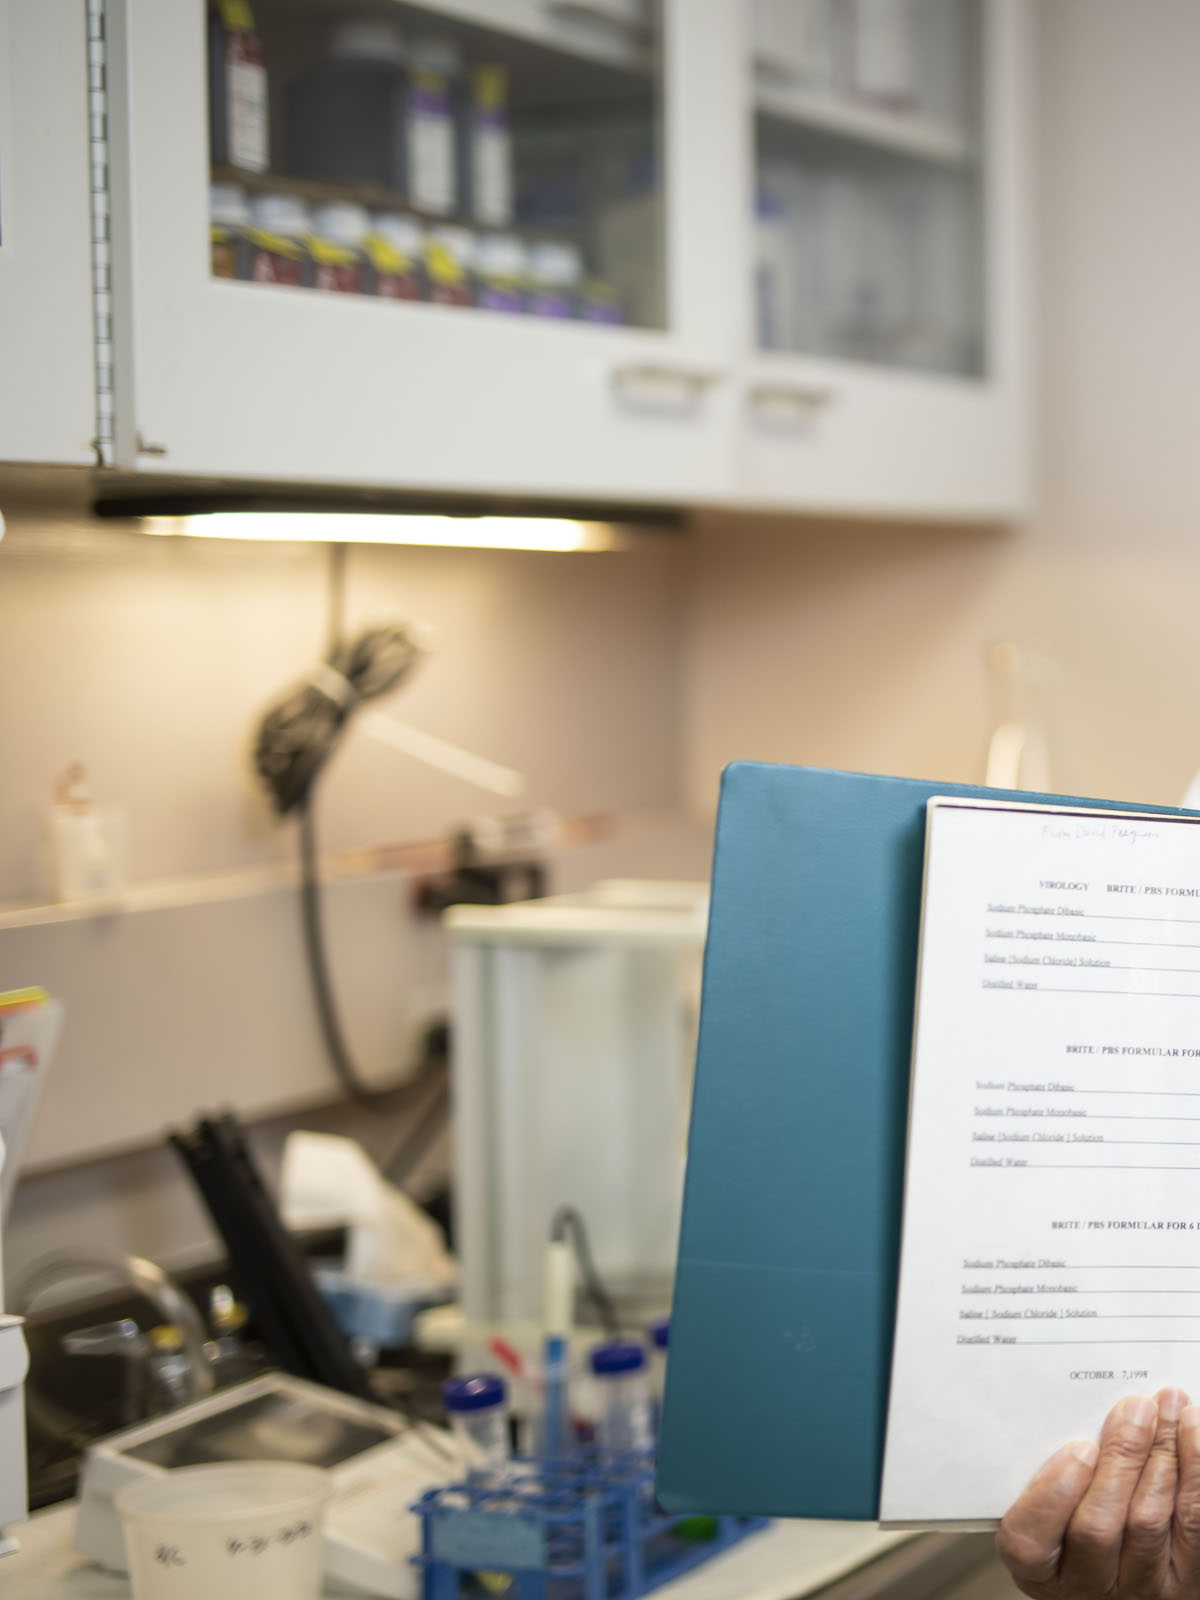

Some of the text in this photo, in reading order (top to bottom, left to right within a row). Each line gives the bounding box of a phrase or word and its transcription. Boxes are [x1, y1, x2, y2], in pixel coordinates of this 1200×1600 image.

[1039, 880, 1089, 894] VIROLOGY
[1106, 884, 1136, 896] BRITE
[1144, 885, 1162, 897] PBS
[1079, 956, 1111, 969] Solution
[1066, 1043, 1094, 1055] BRITE
[1102, 1045, 1119, 1056] PBS
[1122, 1045, 1179, 1058] FORMULAR
[1181, 1047, 1200, 1059] FOR
[1072, 1132, 1103, 1144] Solution
[1051, 1219, 1080, 1231] BRITE
[1088, 1220, 1105, 1231] PBS
[1107, 1220, 1164, 1231] FORMULAR
[1166, 1220, 1186, 1232] FOR
[1065, 1308, 1098, 1320] Solution
[993, 1333, 1017, 1345] Water
[1070, 1369, 1148, 1381] OCTOBER 7,1998
